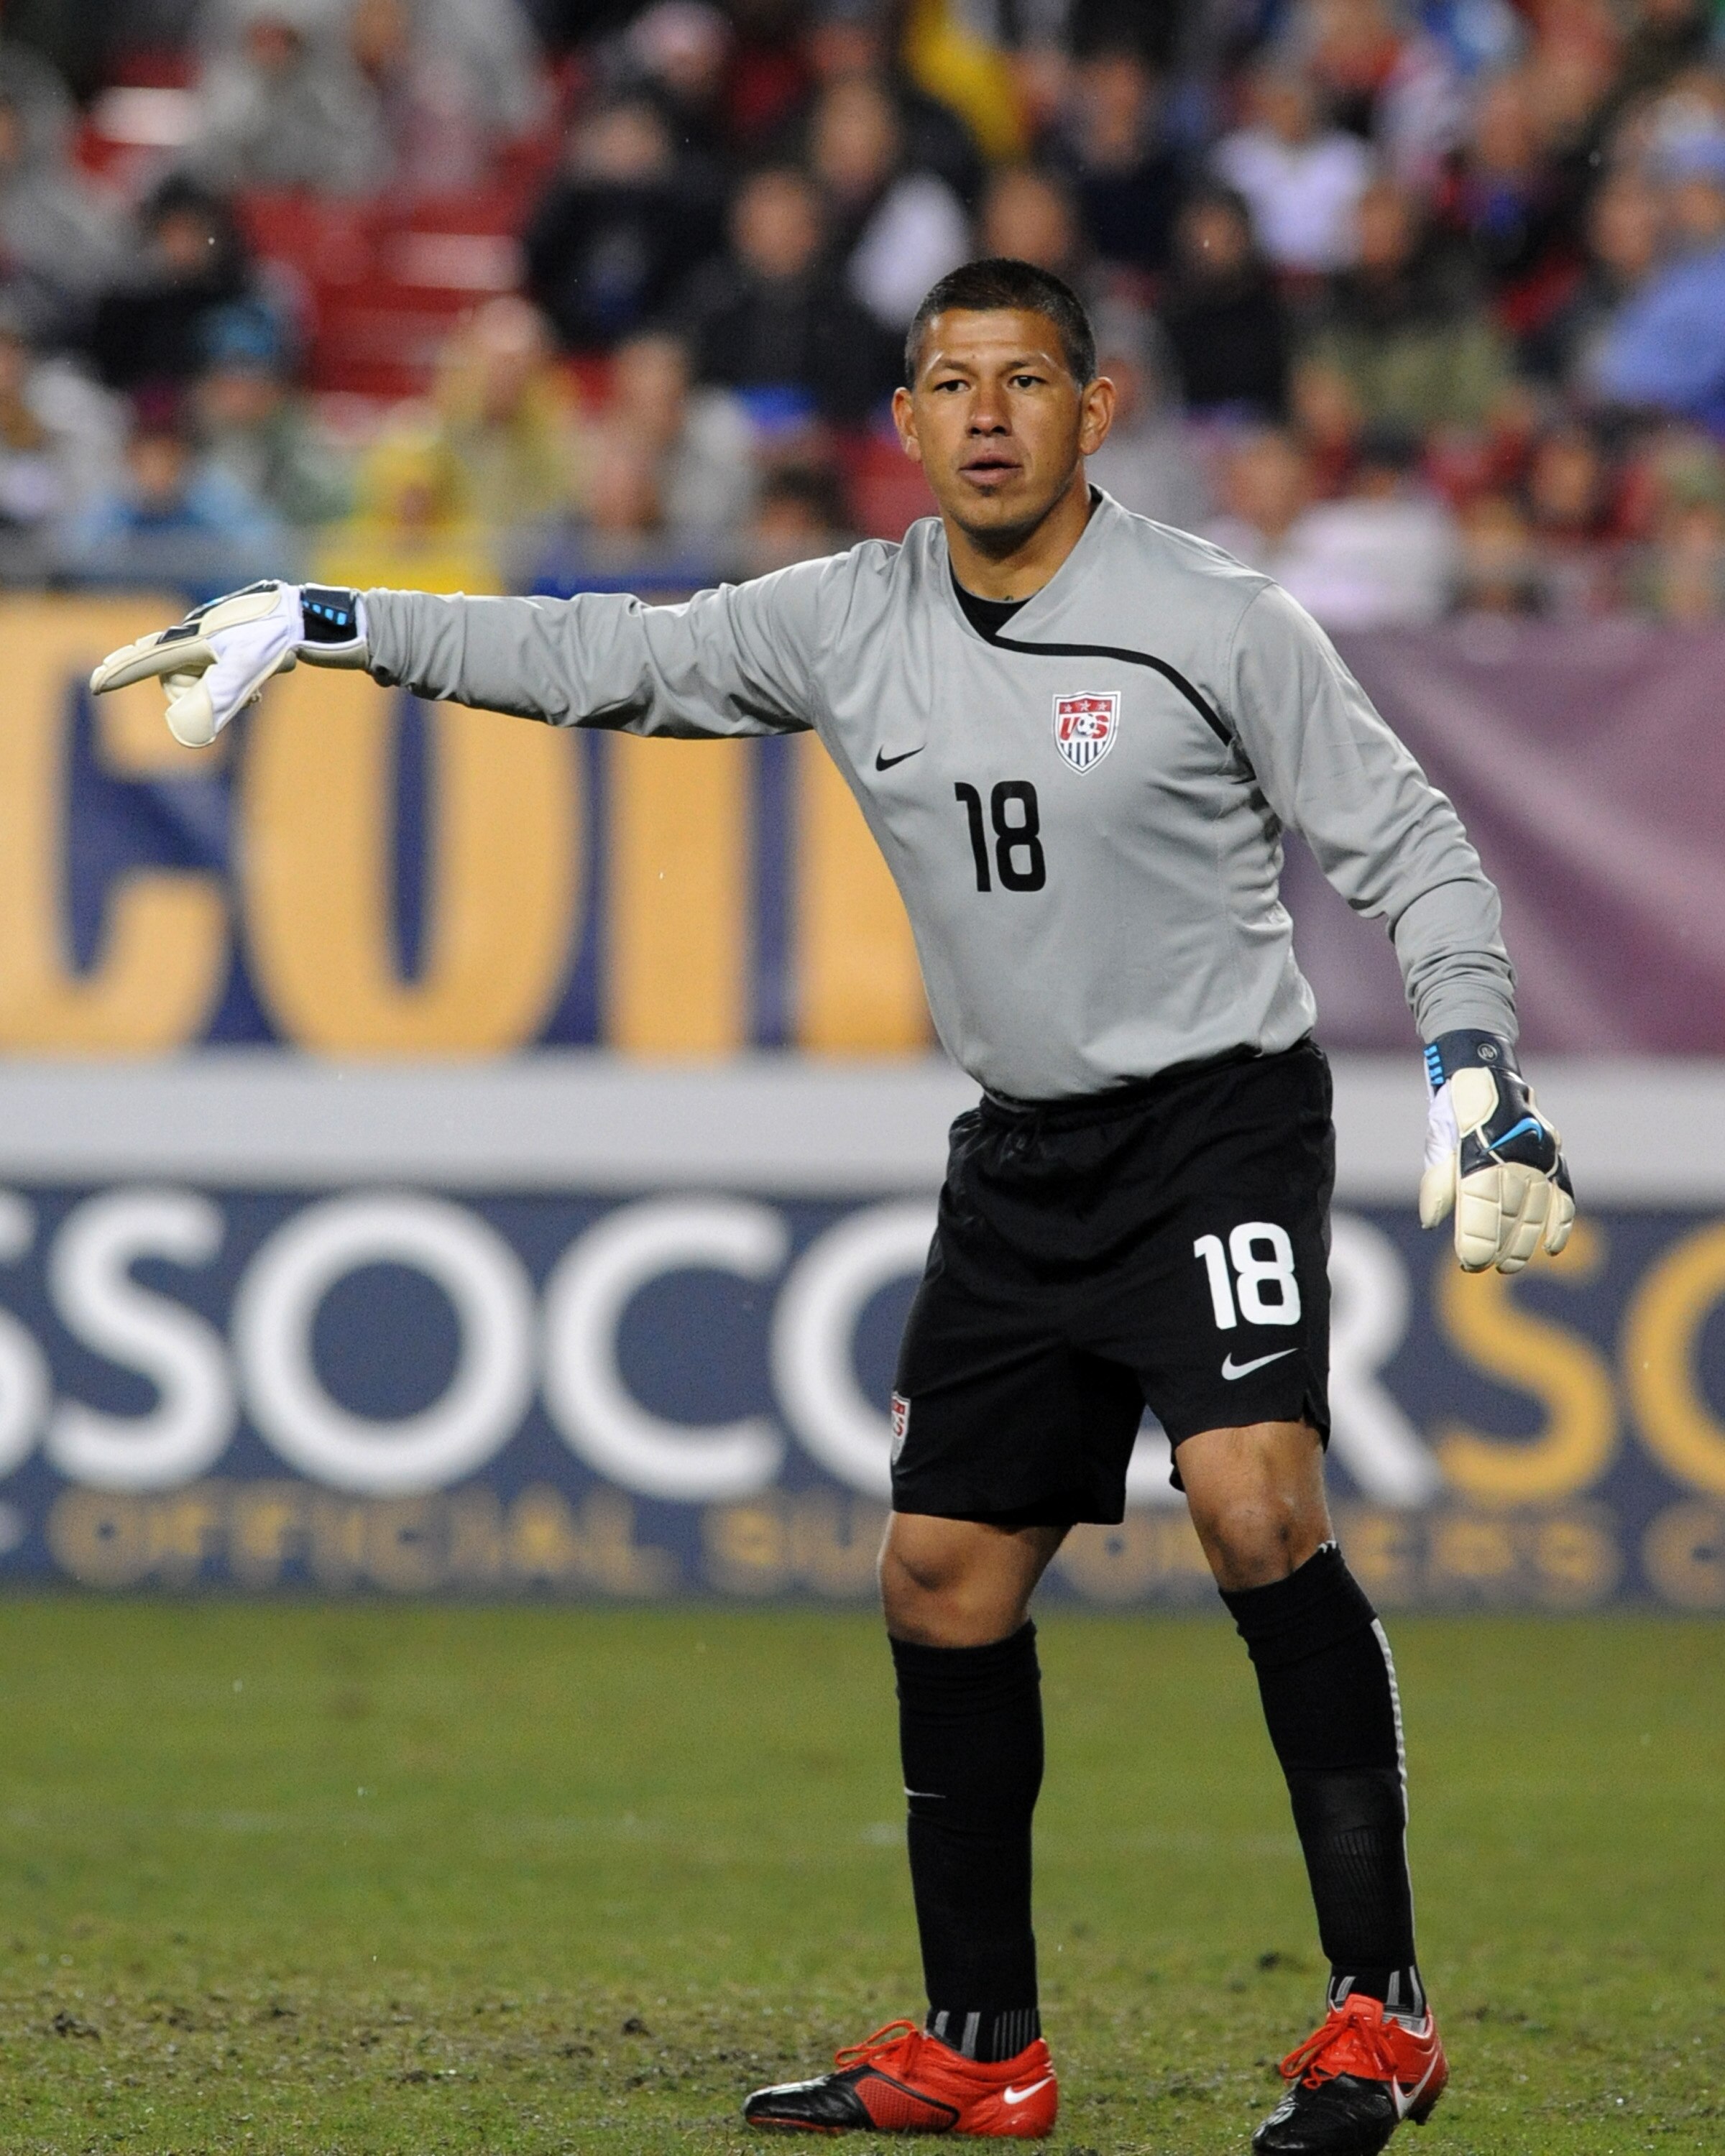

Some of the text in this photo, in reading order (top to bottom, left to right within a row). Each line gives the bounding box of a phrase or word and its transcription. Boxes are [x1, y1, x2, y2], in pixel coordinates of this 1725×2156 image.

[1060, 714, 1109, 741] US
[954, 780, 1046, 892] 18
[1193, 1222, 1301, 1330] 18
